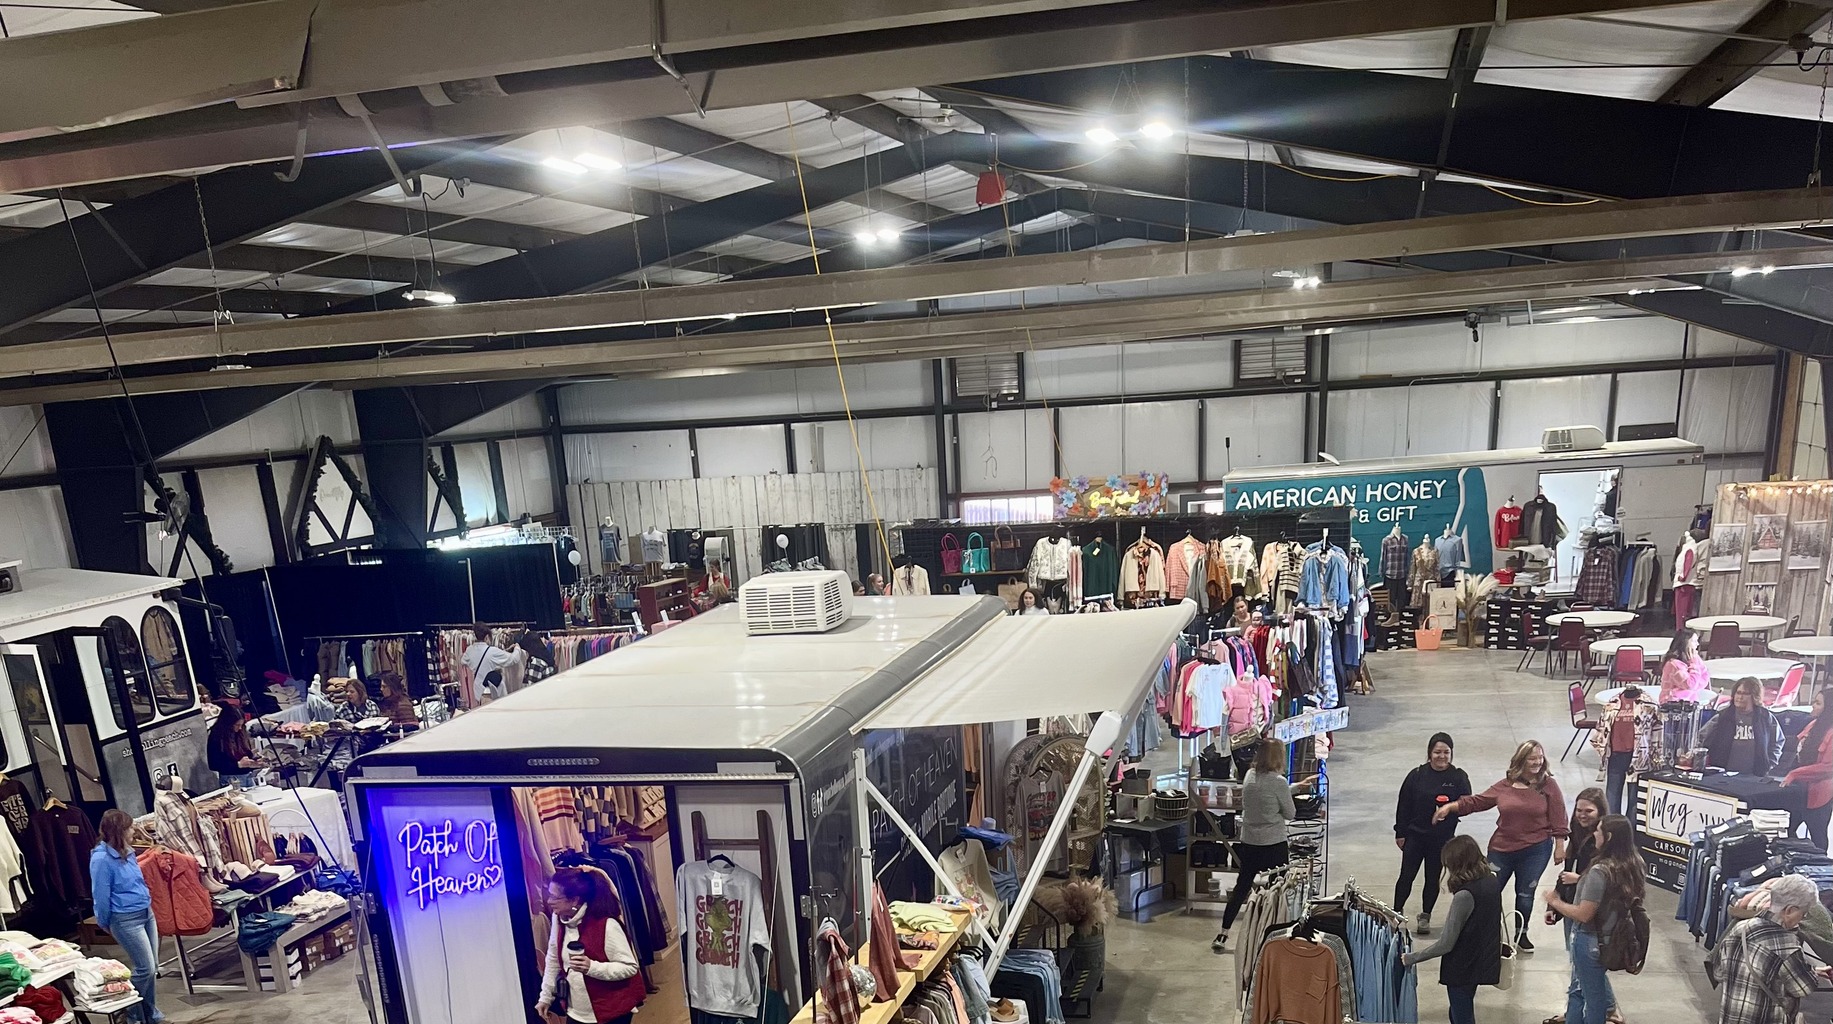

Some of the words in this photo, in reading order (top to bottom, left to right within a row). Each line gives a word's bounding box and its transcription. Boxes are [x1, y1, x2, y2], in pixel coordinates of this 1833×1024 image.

[1235, 484, 1357, 510] AMERICAN
[1365, 479, 1447, 502] HONEY
[1358, 509, 1370, 523] &
[1376, 505, 1418, 522] GIFT
[908, 767, 921, 807] OF
[923, 734, 958, 793] HEAVEN
[398, 819, 459, 870] Patch
[464, 819, 499, 865] Of
[1654, 840, 1686, 856] CARSON
[407, 862, 491, 910] Heaven
[696, 895, 744, 918] GRCH
